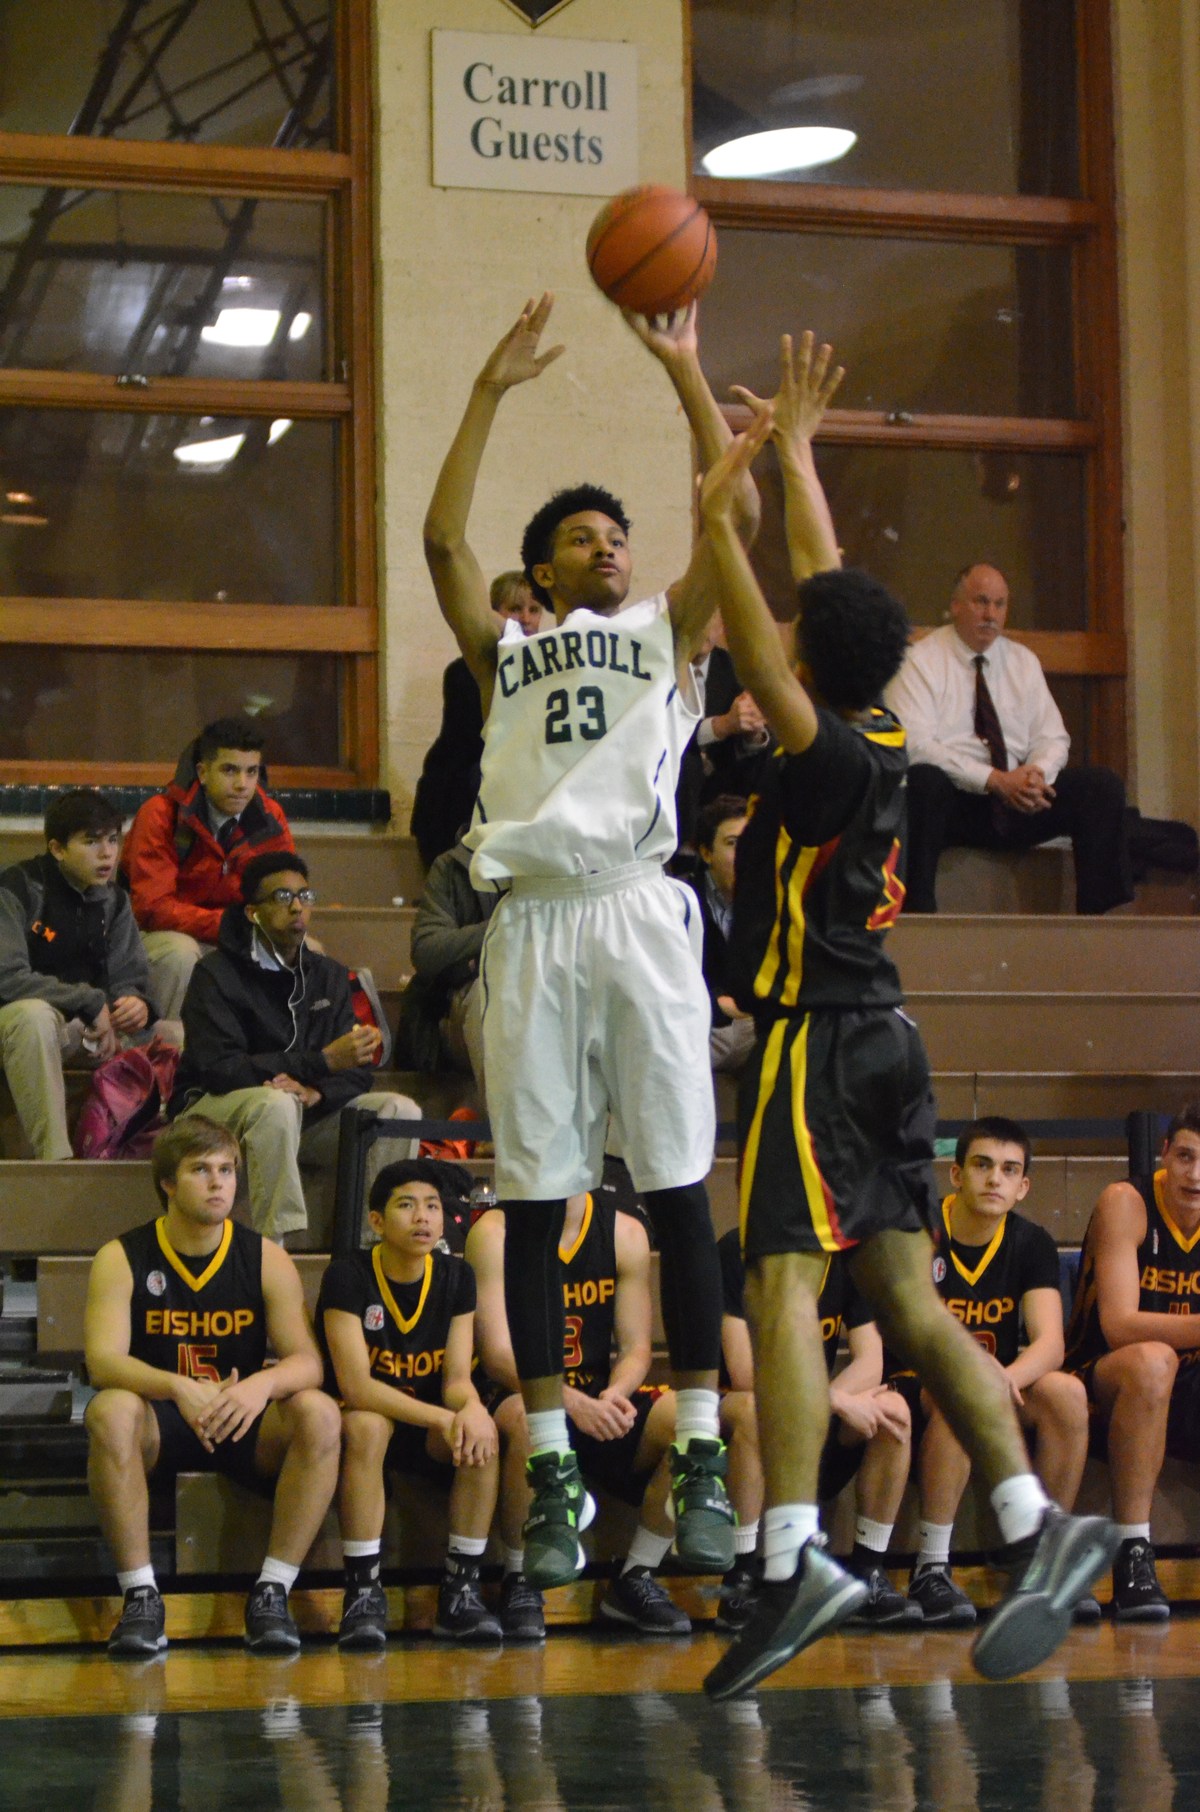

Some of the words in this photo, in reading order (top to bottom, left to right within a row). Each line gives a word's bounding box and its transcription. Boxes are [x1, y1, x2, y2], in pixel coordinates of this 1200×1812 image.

[463, 62, 608, 111] Carroll
[470, 116, 603, 165] Guests
[499, 630, 652, 698] CARROLL
[545, 685, 607, 745] 23
[562, 1278, 615, 1308] HOP
[944, 1296, 1014, 1324] SHOP
